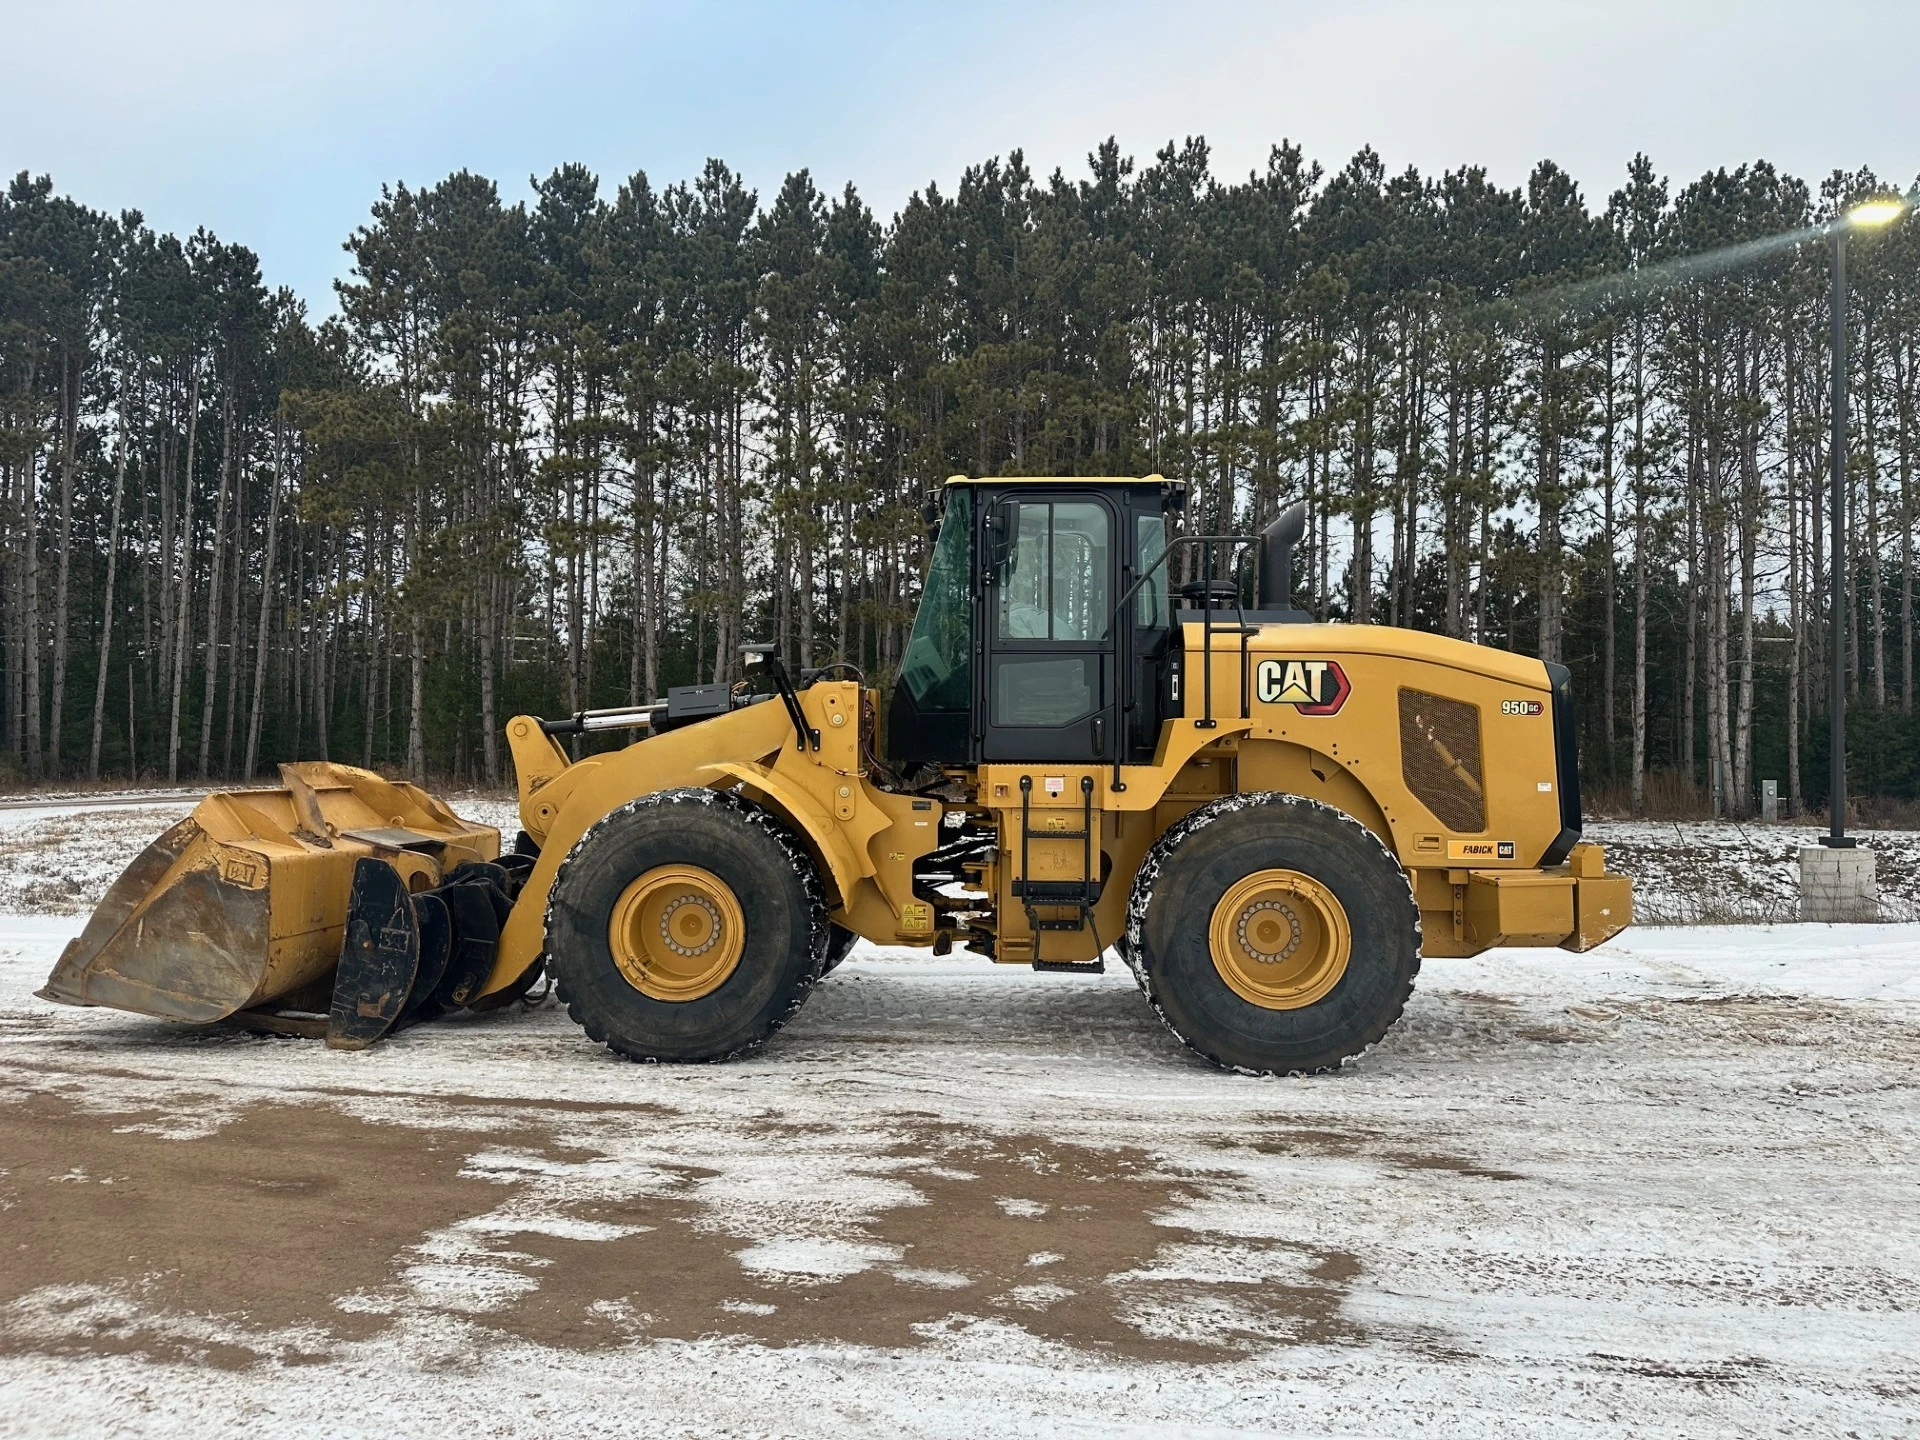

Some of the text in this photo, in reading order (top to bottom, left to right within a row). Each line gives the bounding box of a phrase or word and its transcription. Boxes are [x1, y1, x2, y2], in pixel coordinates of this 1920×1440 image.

[1258, 660, 1327, 703] CAT
[1463, 845, 1513, 855] FABICK CAT
[226, 860, 256, 886] CAT
